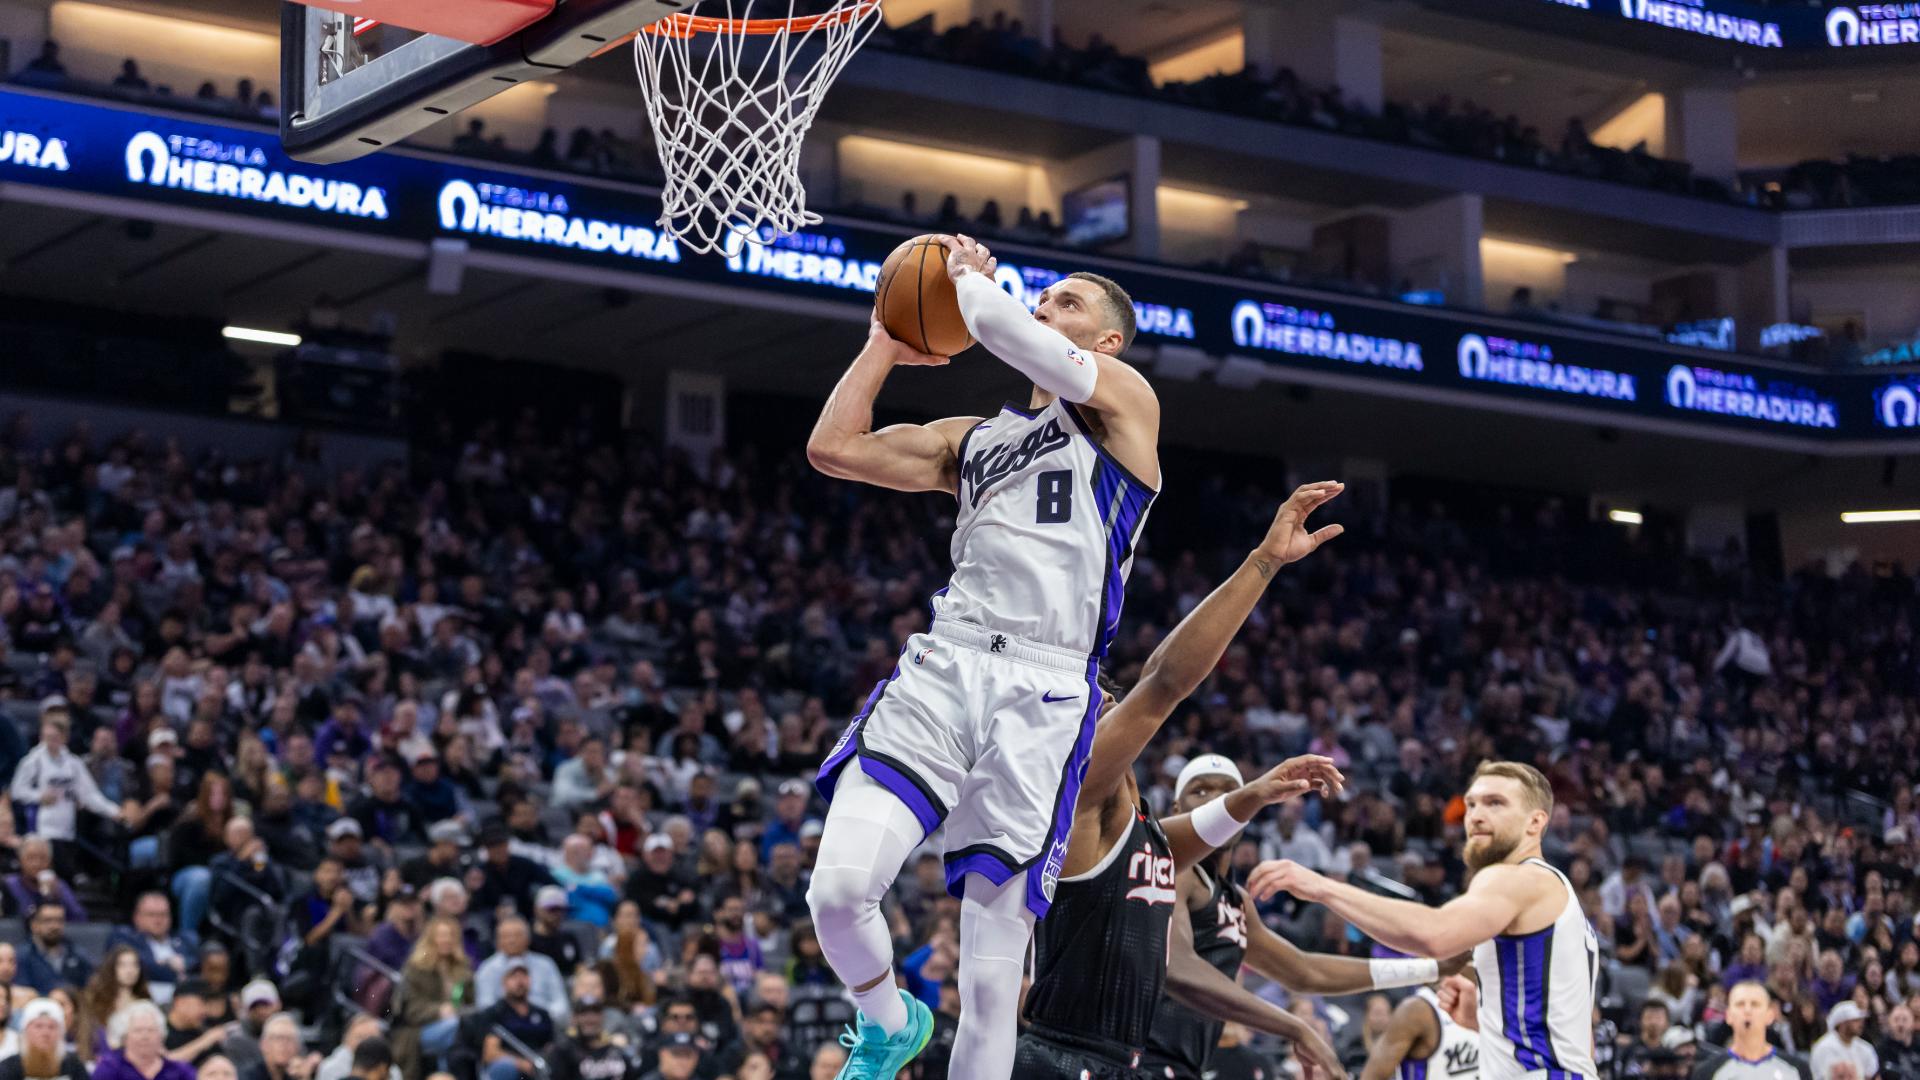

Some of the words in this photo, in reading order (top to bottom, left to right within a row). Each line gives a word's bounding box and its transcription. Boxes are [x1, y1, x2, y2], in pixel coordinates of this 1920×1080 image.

[1648, 2, 1783, 48] HERRADURA
[169, 156, 389, 219] HERRADURA
[479, 202, 681, 264] HERRADURA
[1264, 320, 1424, 372] HERRADURA
[1488, 354, 1636, 402] HERRADURA
[1694, 384, 1837, 429] HERRADURA
[1036, 469, 1073, 524] 8
